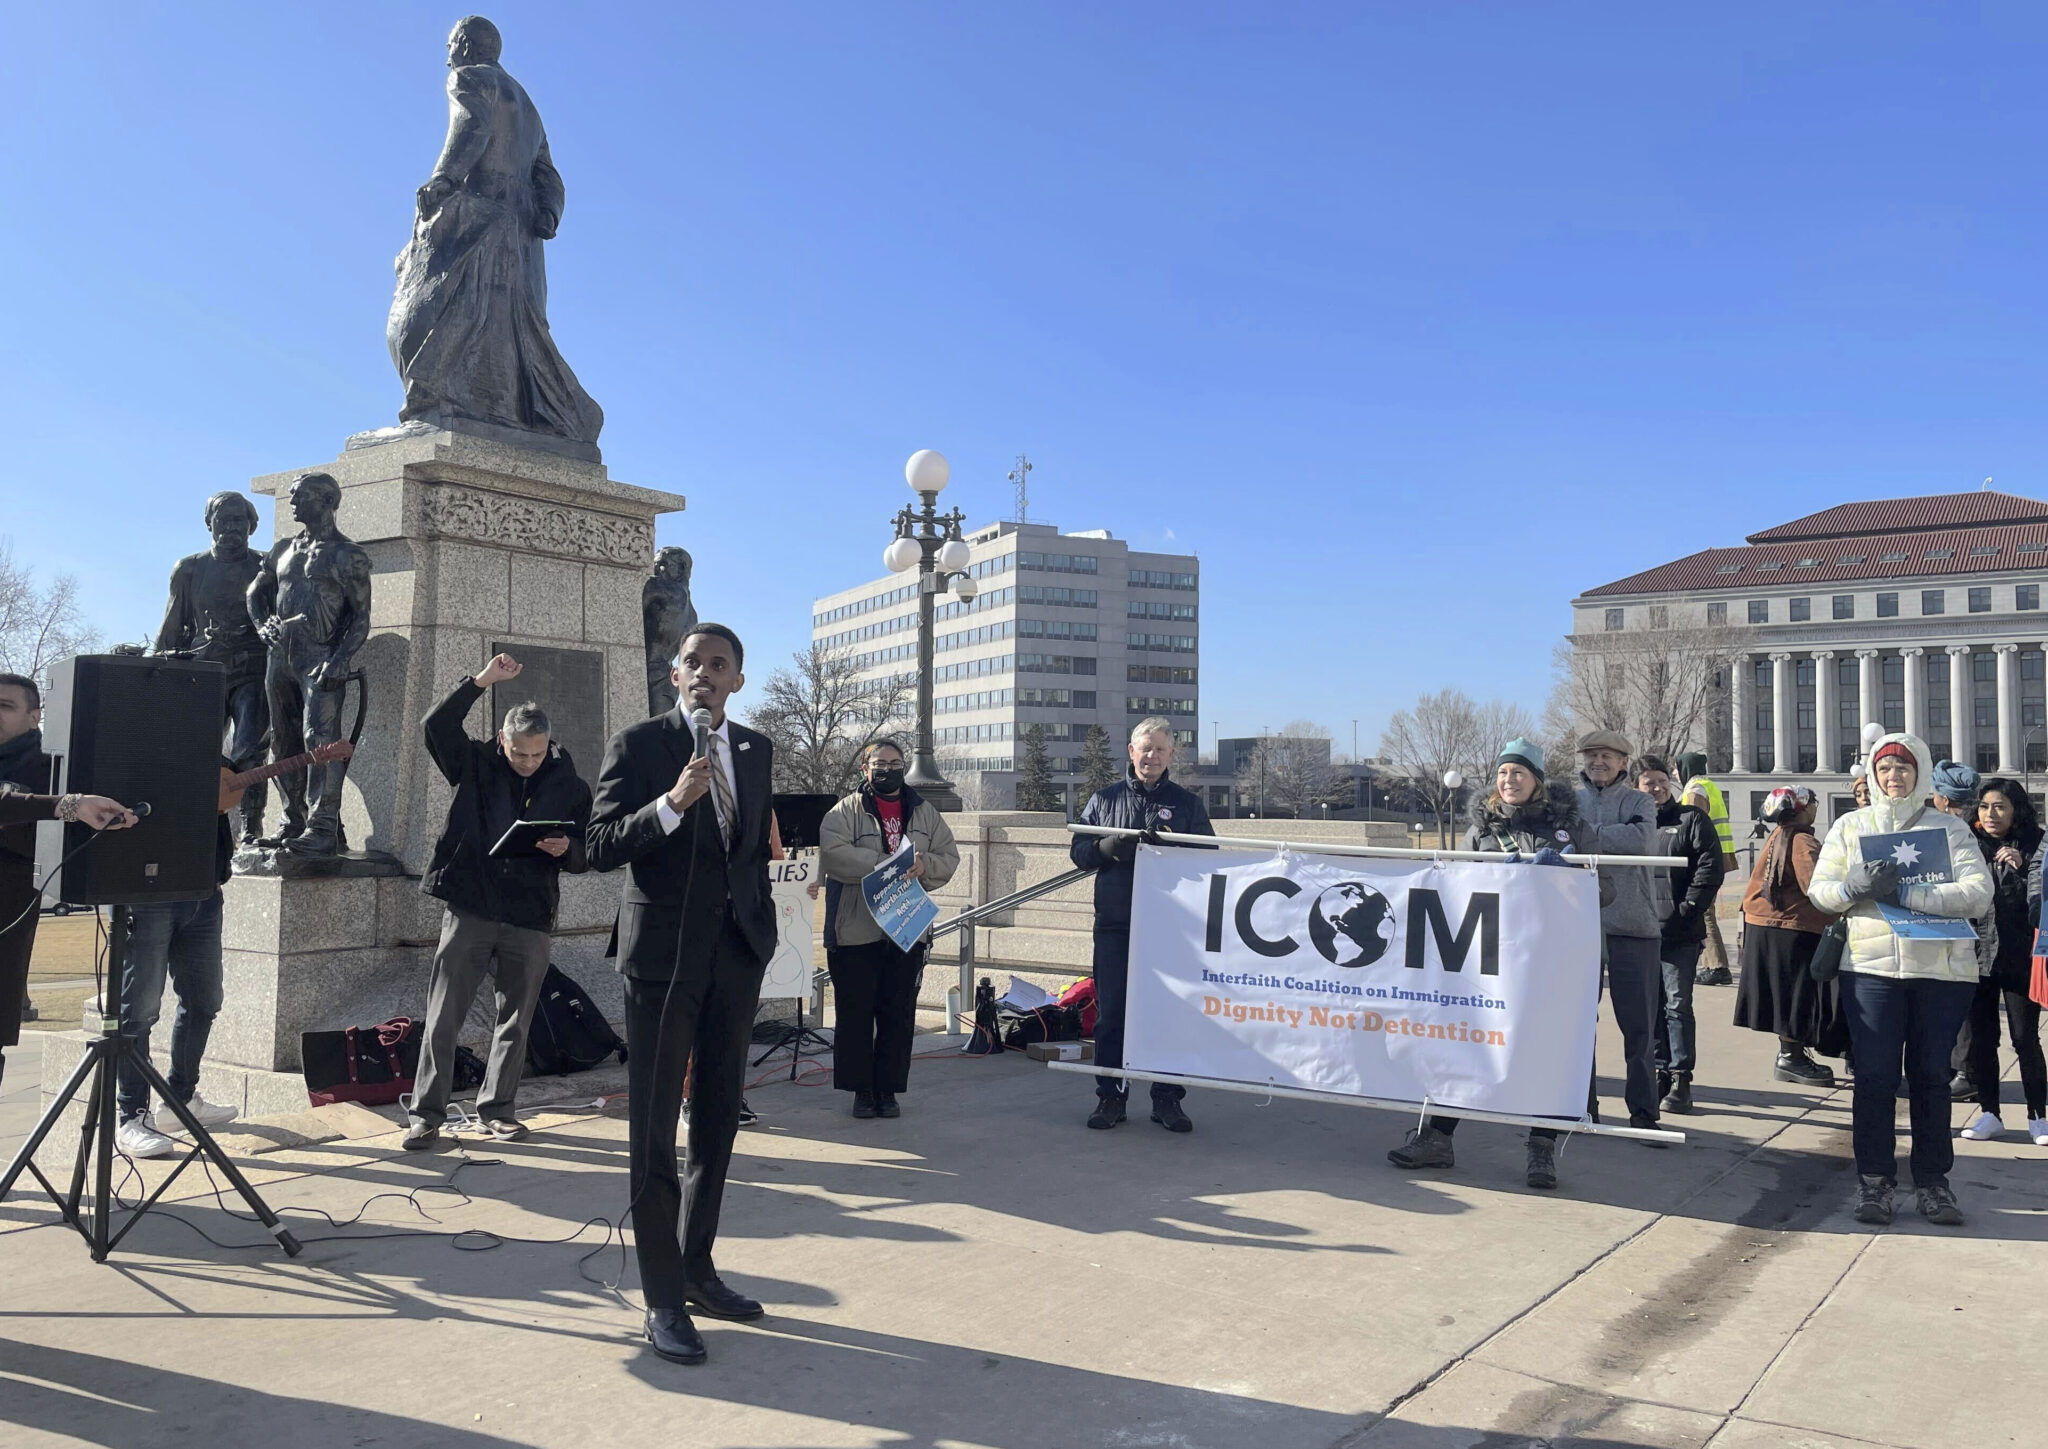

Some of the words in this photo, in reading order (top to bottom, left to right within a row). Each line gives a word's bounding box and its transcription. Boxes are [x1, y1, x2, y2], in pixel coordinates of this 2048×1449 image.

[872, 878, 898, 903] Support
[1925, 871, 1945, 883] the
[878, 892, 899, 914] North
[1205, 873, 1500, 976] ICOM
[1202, 969, 1281, 988] Interfaith
[1284, 976, 1363, 996] Coalition
[1366, 987, 1387, 998] on
[1391, 986, 1506, 1010] Immigration
[1203, 996, 1304, 1029] Dignity
[1308, 1005, 1357, 1030] Not
[1362, 1011, 1506, 1046] Detention
